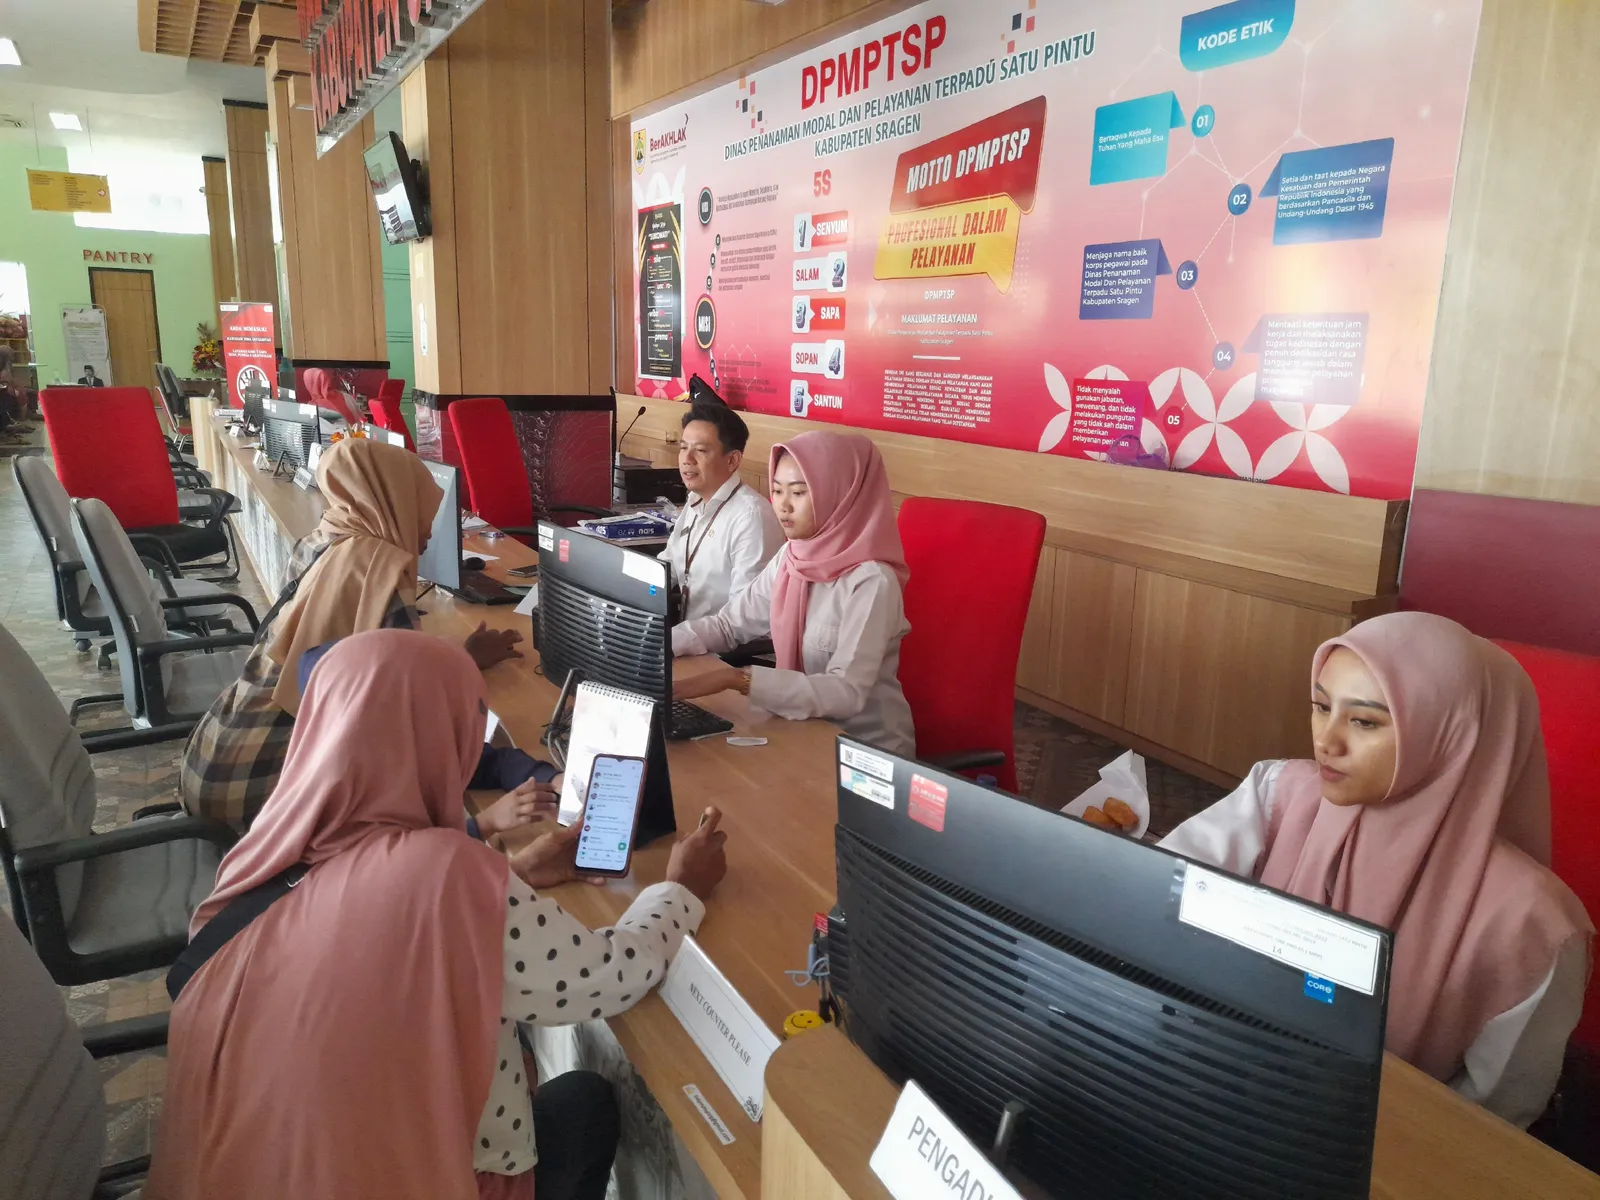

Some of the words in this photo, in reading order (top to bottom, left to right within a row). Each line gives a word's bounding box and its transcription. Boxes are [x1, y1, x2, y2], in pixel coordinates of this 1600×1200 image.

[1198, 29, 1237, 51] KODE
[1240, 19, 1274, 40] ETIK
[802, 15, 946, 110] DPMPTSP
[724, 144, 746, 160] DINAS
[749, 126, 800, 151] PENANAMAN
[803, 112, 836, 134] MODAL
[840, 103, 860, 123] DAN
[864, 83, 931, 120] PELAYANAN
[1000, 48, 1038, 78] SATU
[1044, 31, 1095, 67] PINTU
[1196, 115, 1209, 128] 01
[650, 127, 686, 152] BerAKHLAK
[814, 124, 872, 157] KABUPATEN
[876, 113, 921, 142] SRAGEN
[1099, 132, 1127, 144] Bertaqwa
[1129, 128, 1151, 138] Kepada
[1134, 138, 1151, 146] Maha
[906, 154, 952, 193] MOTTO
[956, 128, 1030, 178] DPMPTSP
[1330, 168, 1356, 180] kepada
[1358, 165, 1385, 175] Negara
[814, 169, 831, 196] 5S
[1281, 183, 1312, 192] Kesatuan
[1329, 177, 1371, 187] Pemerintah
[1233, 194, 1247, 206] 02
[1280, 191, 1309, 202] Republik
[1311, 188, 1345, 198] Indonesia
[1346, 186, 1364, 196] yang
[1279, 199, 1320, 210] berdasarkan
[1322, 196, 1355, 205] Pancasila
[1278, 208, 1333, 218] Undang-Undang
[1335, 204, 1356, 213] Dasar
[817, 218, 847, 237] SENYUM
[887, 215, 958, 244] PROFESIONAL
[962, 208, 1008, 236] DALAM
[83, 250, 154, 264] PANTRY
[910, 242, 976, 269] PELAYANAN
[1086, 252, 1112, 261] Menjaga
[1133, 248, 1147, 256] baik
[1104, 260, 1130, 269] pegawai
[796, 268, 819, 282] SALAM
[1181, 270, 1194, 281] 03
[1118, 278, 1151, 287] Pelayanan
[925, 290, 955, 299] DPMPTSP
[1084, 289, 1108, 297] Terpadu
[1083, 298, 1115, 306] Kabupaten
[1117, 297, 1139, 305] Sragen
[821, 307, 840, 320] SAPA
[902, 314, 936, 323] MAKLUMAT
[937, 314, 977, 323] PELAYANAN
[1303, 320, 1344, 328] ketentuan
[1345, 321, 1361, 329] jam
[1267, 331, 1285, 339] kerja
[1266, 340, 1286, 348] tugas
[796, 352, 818, 365] SOPAN
[1216, 351, 1231, 362] 04
[814, 394, 842, 409] SANTUN
[1168, 416, 1180, 424] 05
[1073, 428, 1108, 436] memberikan
[1073, 435, 1101, 445] pelayanan
[690, 982, 704, 1005] NEXT
[702, 1001, 731, 1040] COUNTER
[728, 1034, 752, 1067] PLEASE
[908, 1115, 993, 1200] PENGAD
